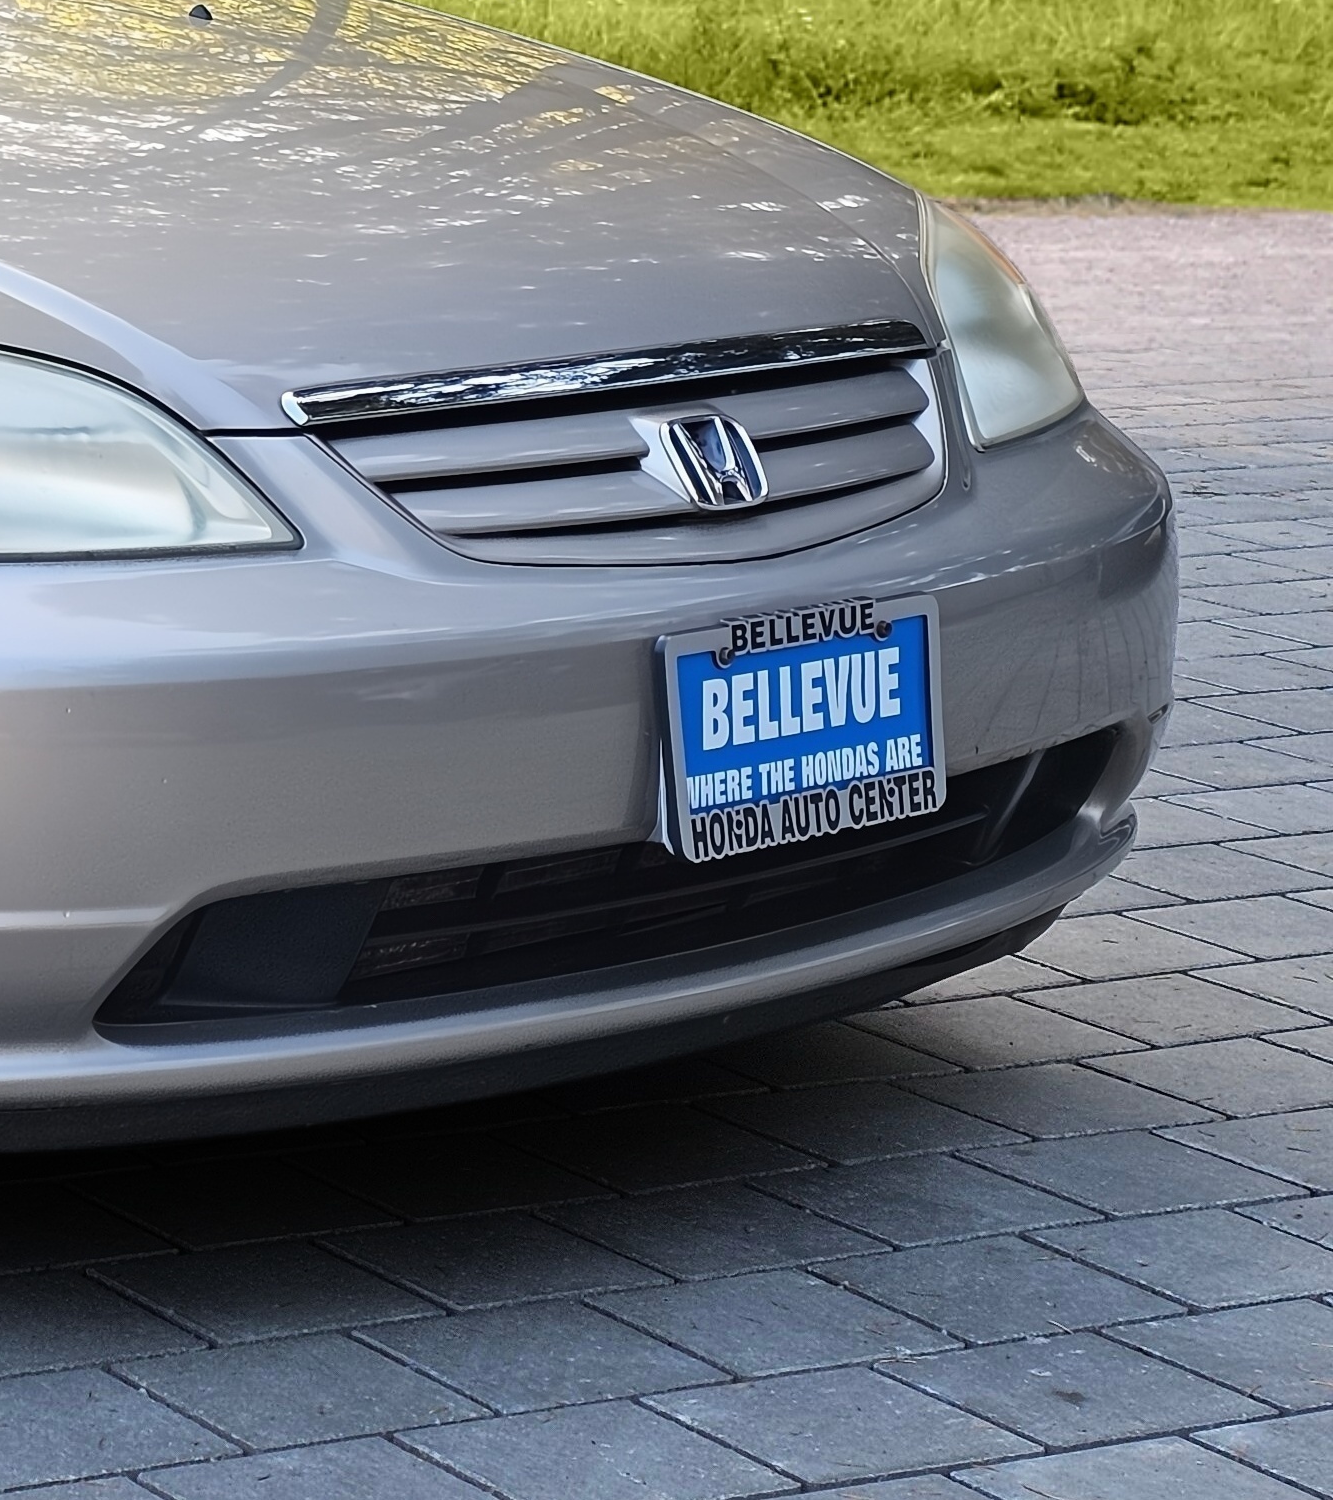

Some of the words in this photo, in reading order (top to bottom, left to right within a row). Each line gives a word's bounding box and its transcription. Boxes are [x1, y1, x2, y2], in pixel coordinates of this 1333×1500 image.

[732, 602, 875, 651] BELLEVUE
[702, 646, 901, 751] BELLEVUE
[758, 758, 795, 796] THE
[801, 741, 880, 787] HONDAS
[885, 733, 923, 772] ARE
[690, 803, 776, 861] HONDA
[781, 788, 841, 841] AUTO
[848, 771, 938, 826] CENTER
